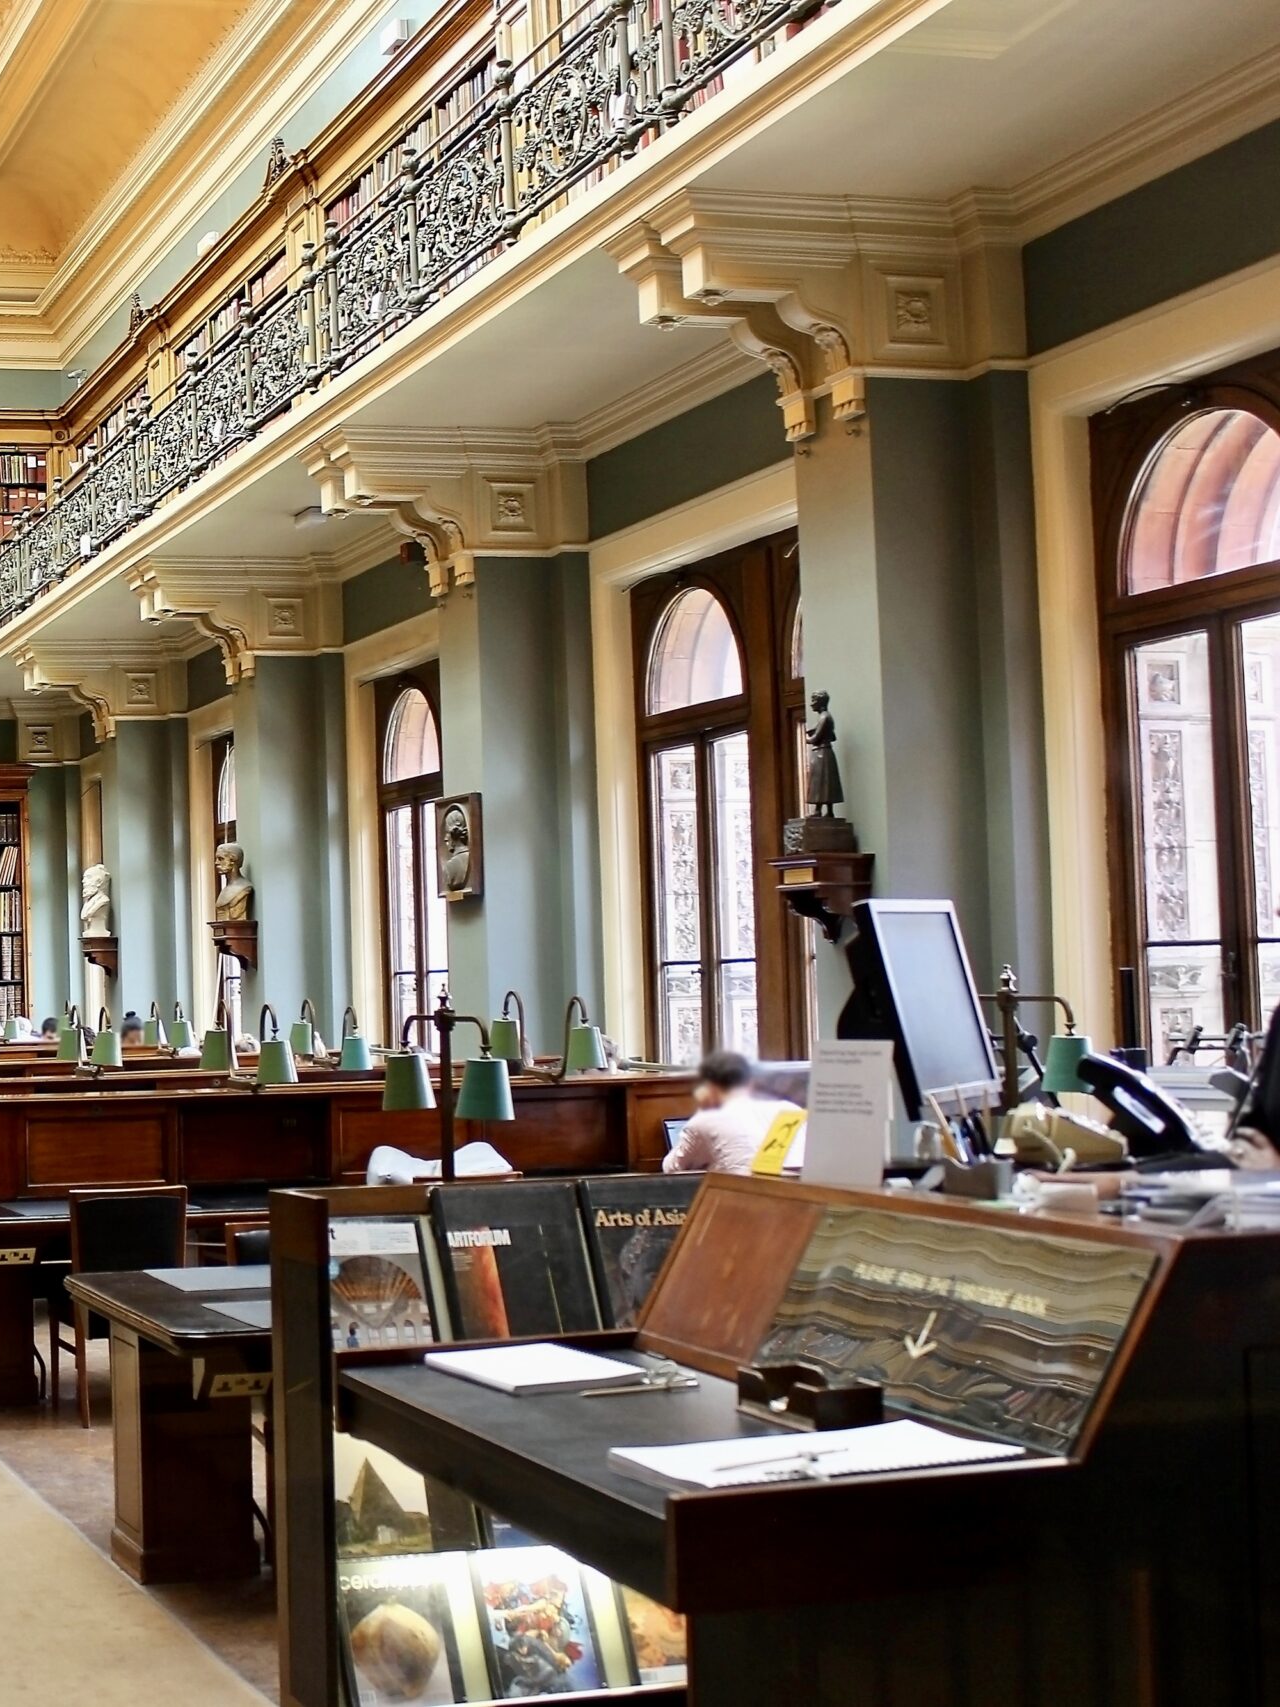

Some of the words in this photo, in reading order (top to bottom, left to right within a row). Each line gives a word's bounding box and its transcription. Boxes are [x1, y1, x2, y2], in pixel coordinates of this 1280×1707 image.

[594, 1209, 633, 1228] Arts
[634, 1208, 652, 1227] of
[652, 1207, 687, 1226] Asia
[447, 1228, 512, 1248] ARTFORUM
